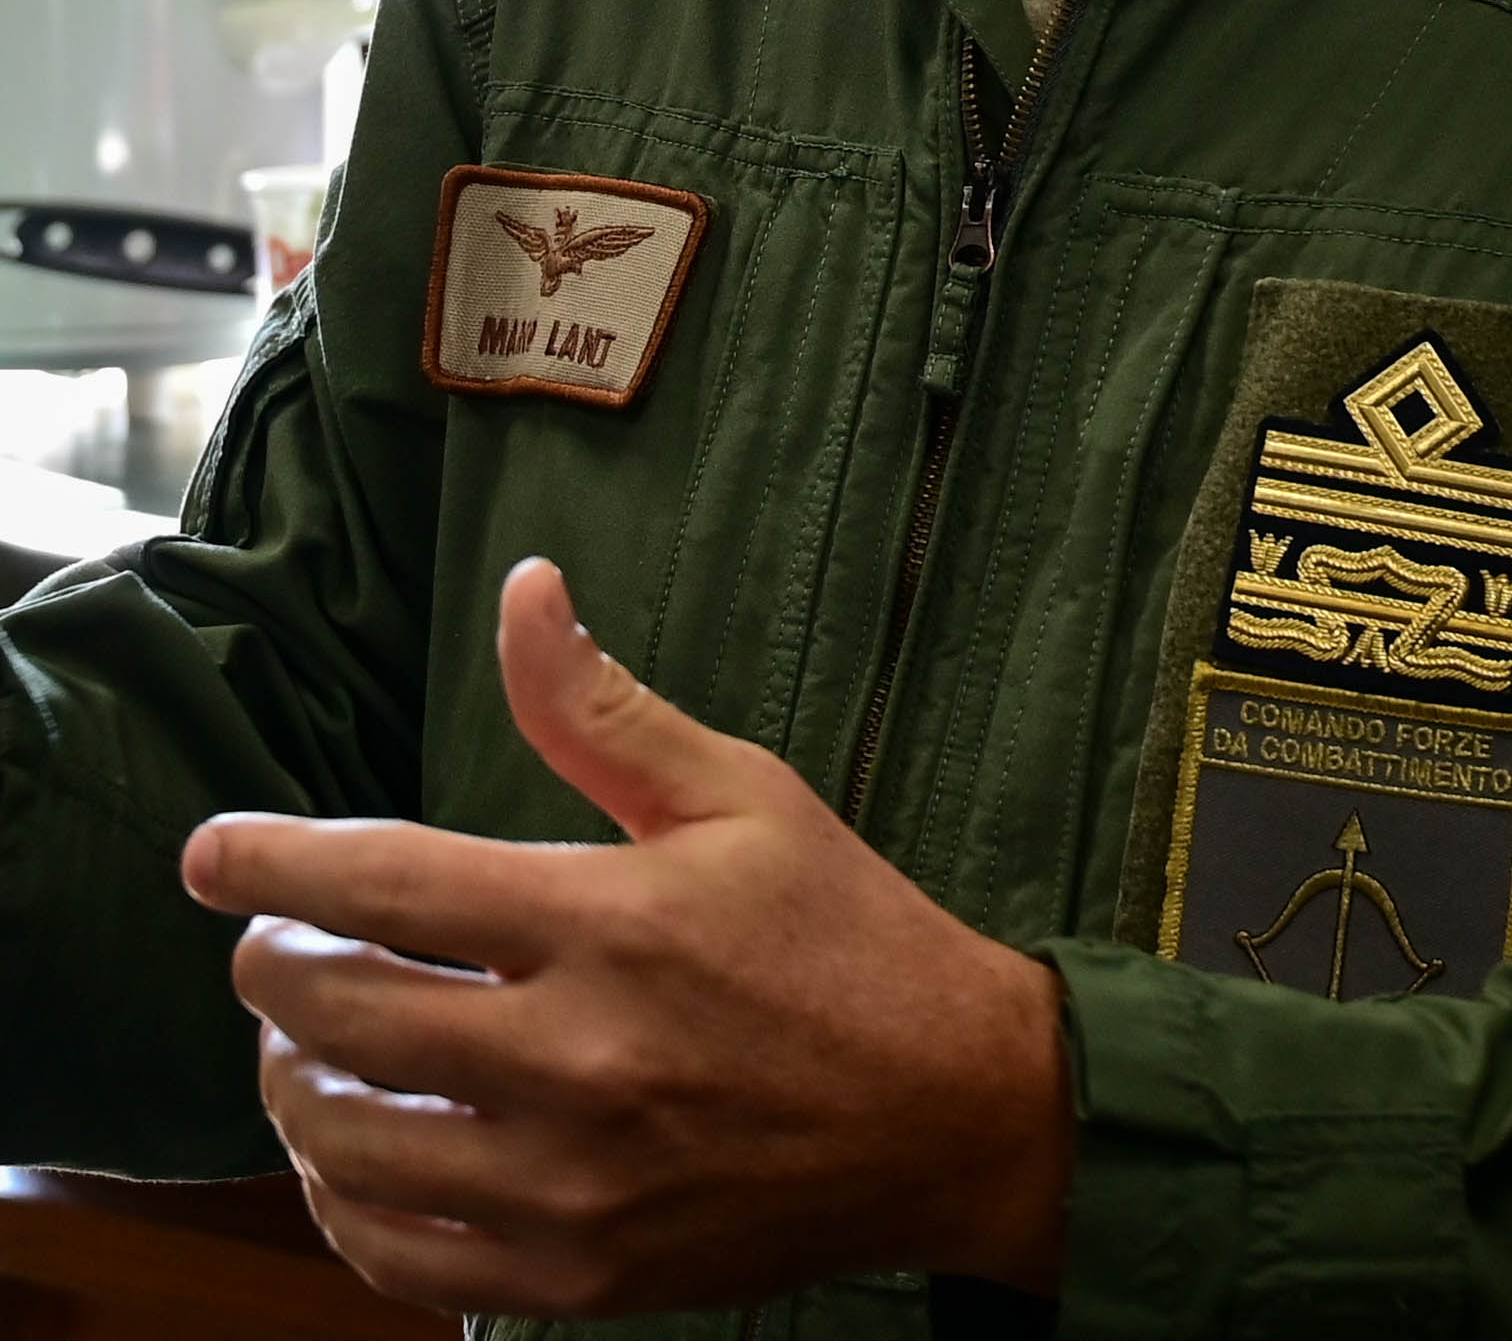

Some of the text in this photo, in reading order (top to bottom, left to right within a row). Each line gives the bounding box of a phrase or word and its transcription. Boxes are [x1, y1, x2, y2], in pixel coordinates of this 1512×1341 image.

[544, 320, 617, 369] LANT
[1240, 702, 1494, 759] COMANDO FORZE
[1212, 727, 1512, 794] DA COMBATTIMENTO
